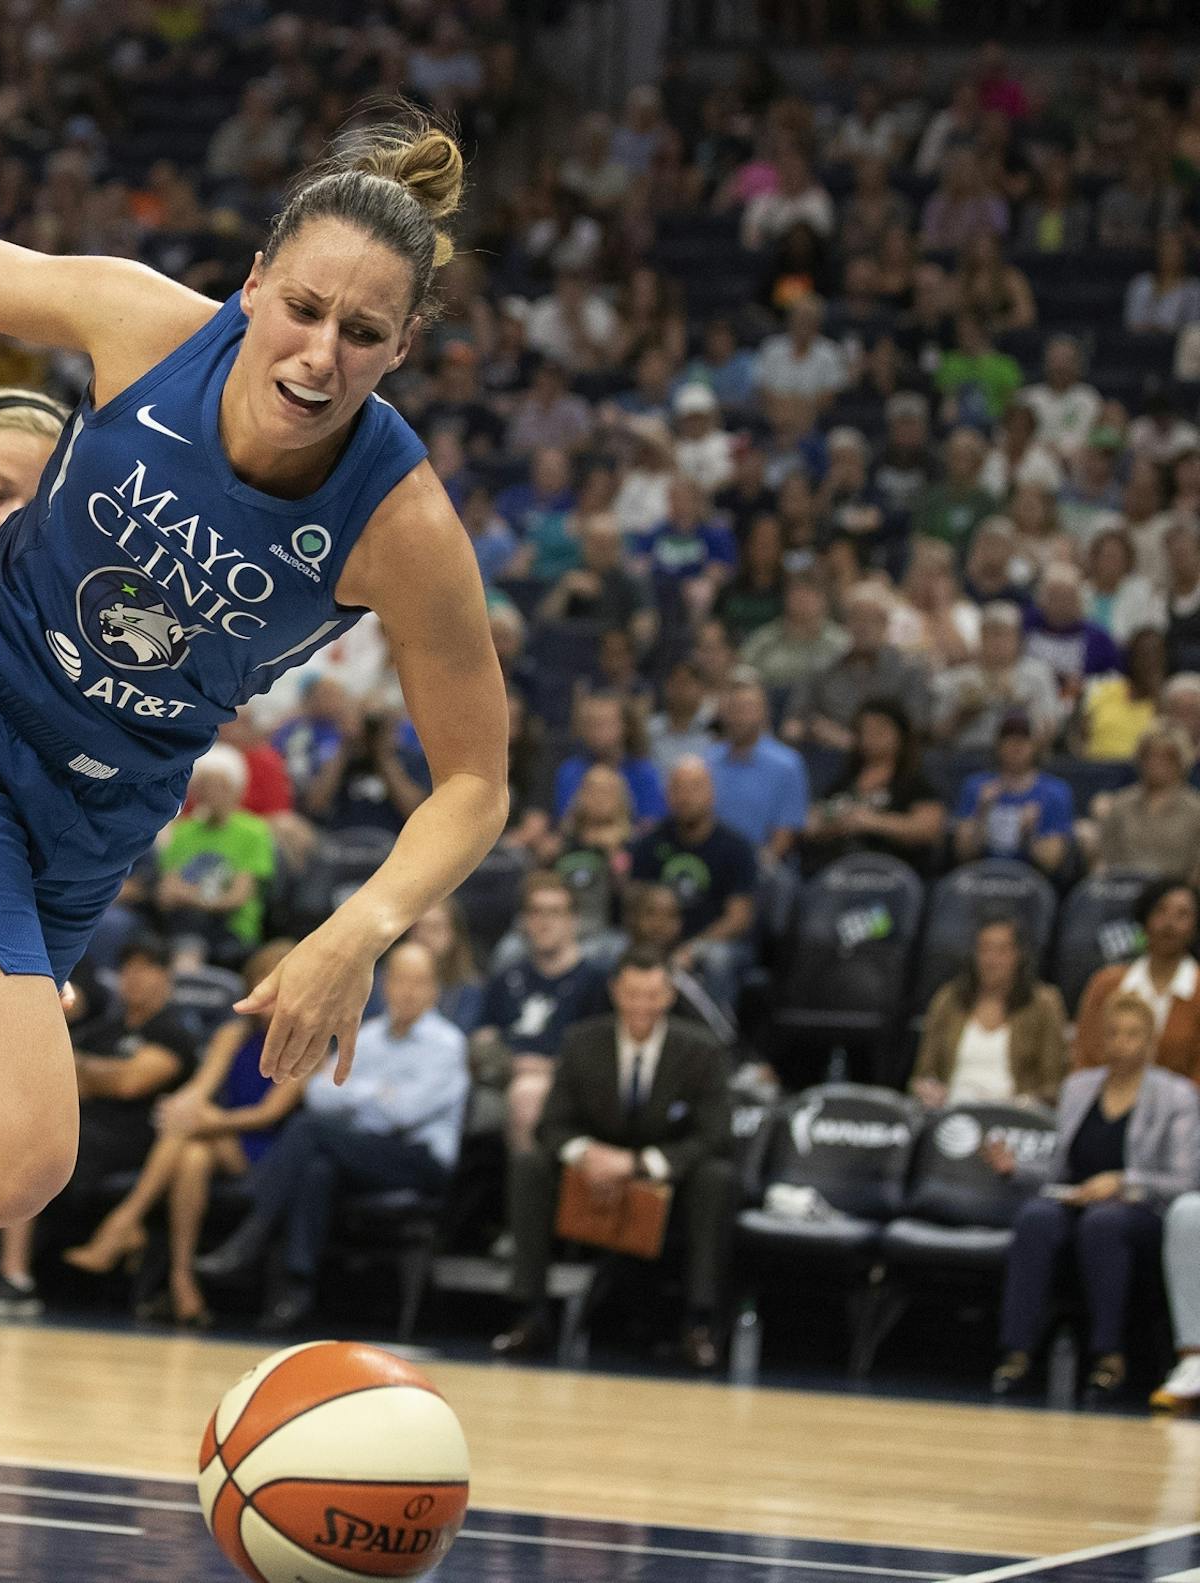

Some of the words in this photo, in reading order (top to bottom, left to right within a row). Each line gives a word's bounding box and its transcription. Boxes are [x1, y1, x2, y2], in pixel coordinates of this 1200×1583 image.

[87, 492, 267, 640] CLINIC
[113, 460, 274, 603] MAYO
[269, 544, 321, 583] sharecare
[83, 676, 196, 719] AT&T
